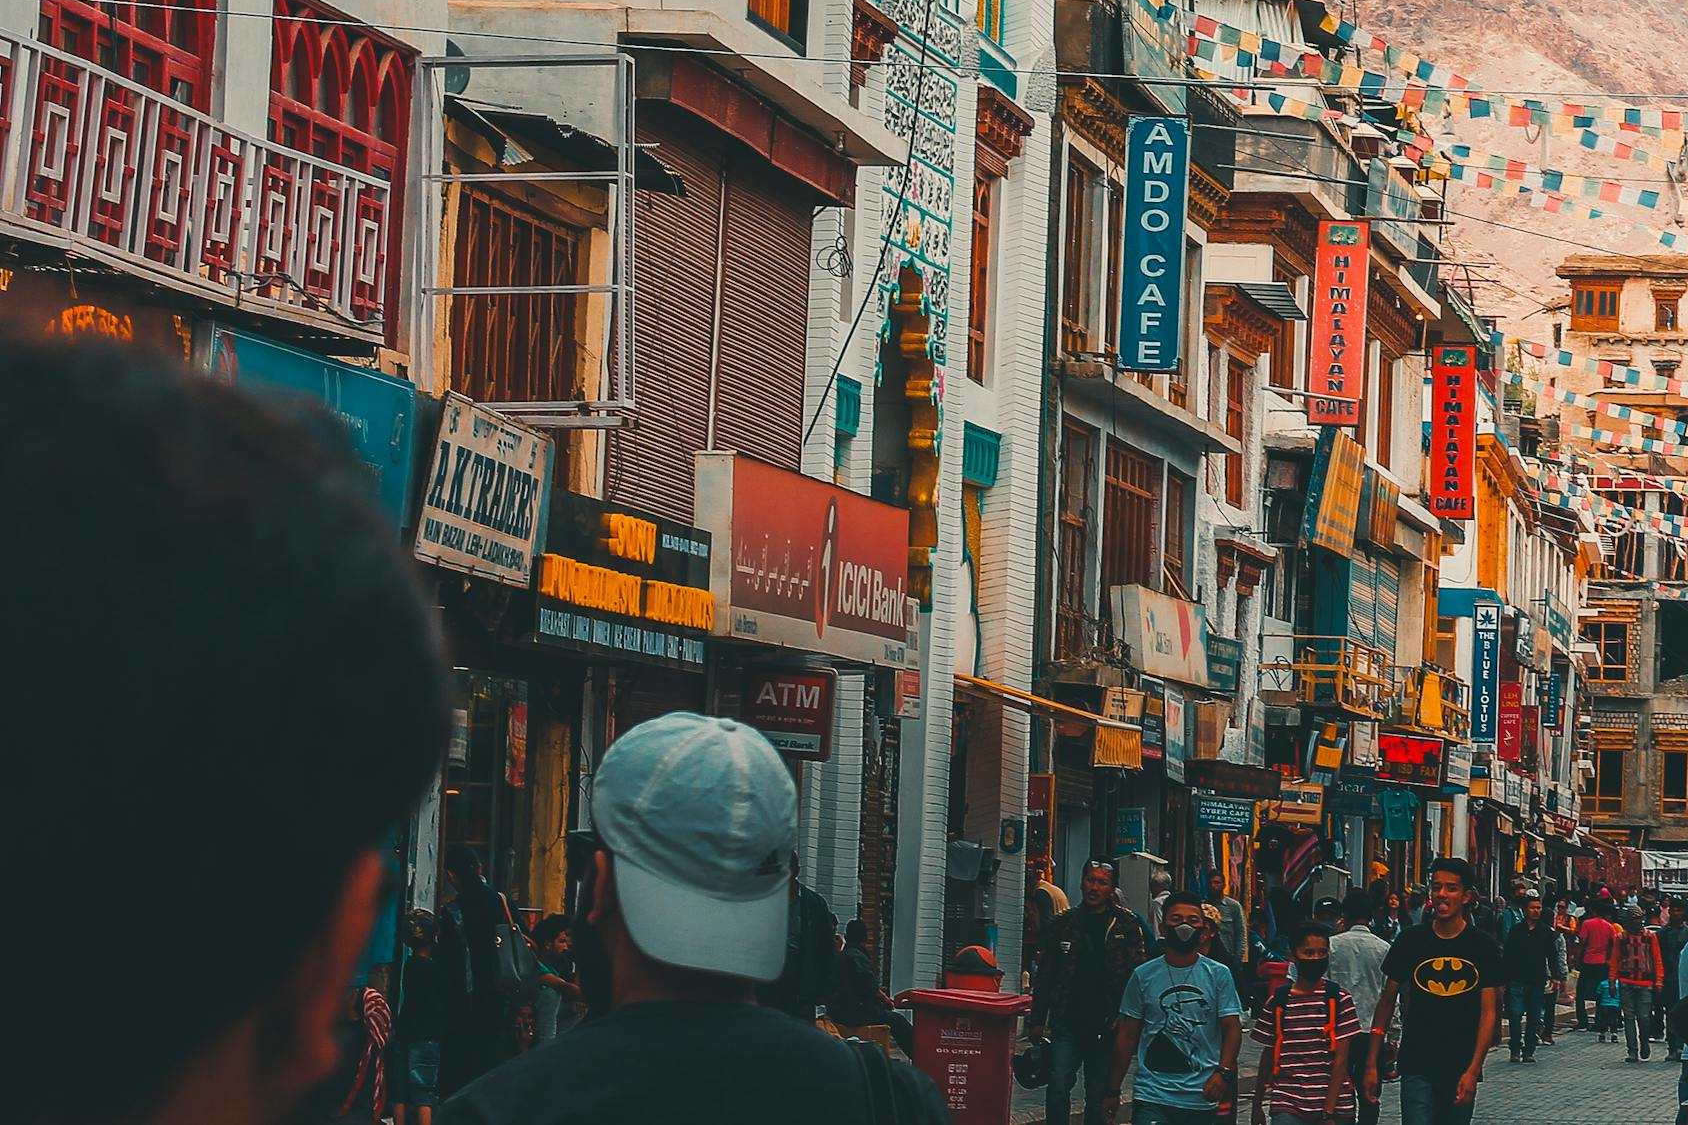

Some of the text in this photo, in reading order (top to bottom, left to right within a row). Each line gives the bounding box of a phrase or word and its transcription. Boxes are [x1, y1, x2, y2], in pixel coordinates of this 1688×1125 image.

[1135, 122, 1174, 366] AMDO CAFE
[1326, 254, 1351, 393] HIMALAYAN
[1314, 399, 1355, 417] CAFE
[1443, 374, 1462, 491] HIMALAYAN
[1434, 496, 1468, 512] CAFE
[837, 560, 907, 628] ICICI Bank
[1478, 631, 1496, 641] THE
[1481, 640, 1491, 680] BLUE
[755, 681, 821, 710] ATM
[1480, 685, 1491, 733] LOTUS
[1200, 806, 1251, 819] CYBER CAFE
[951, 1048, 982, 1056] GREEN
